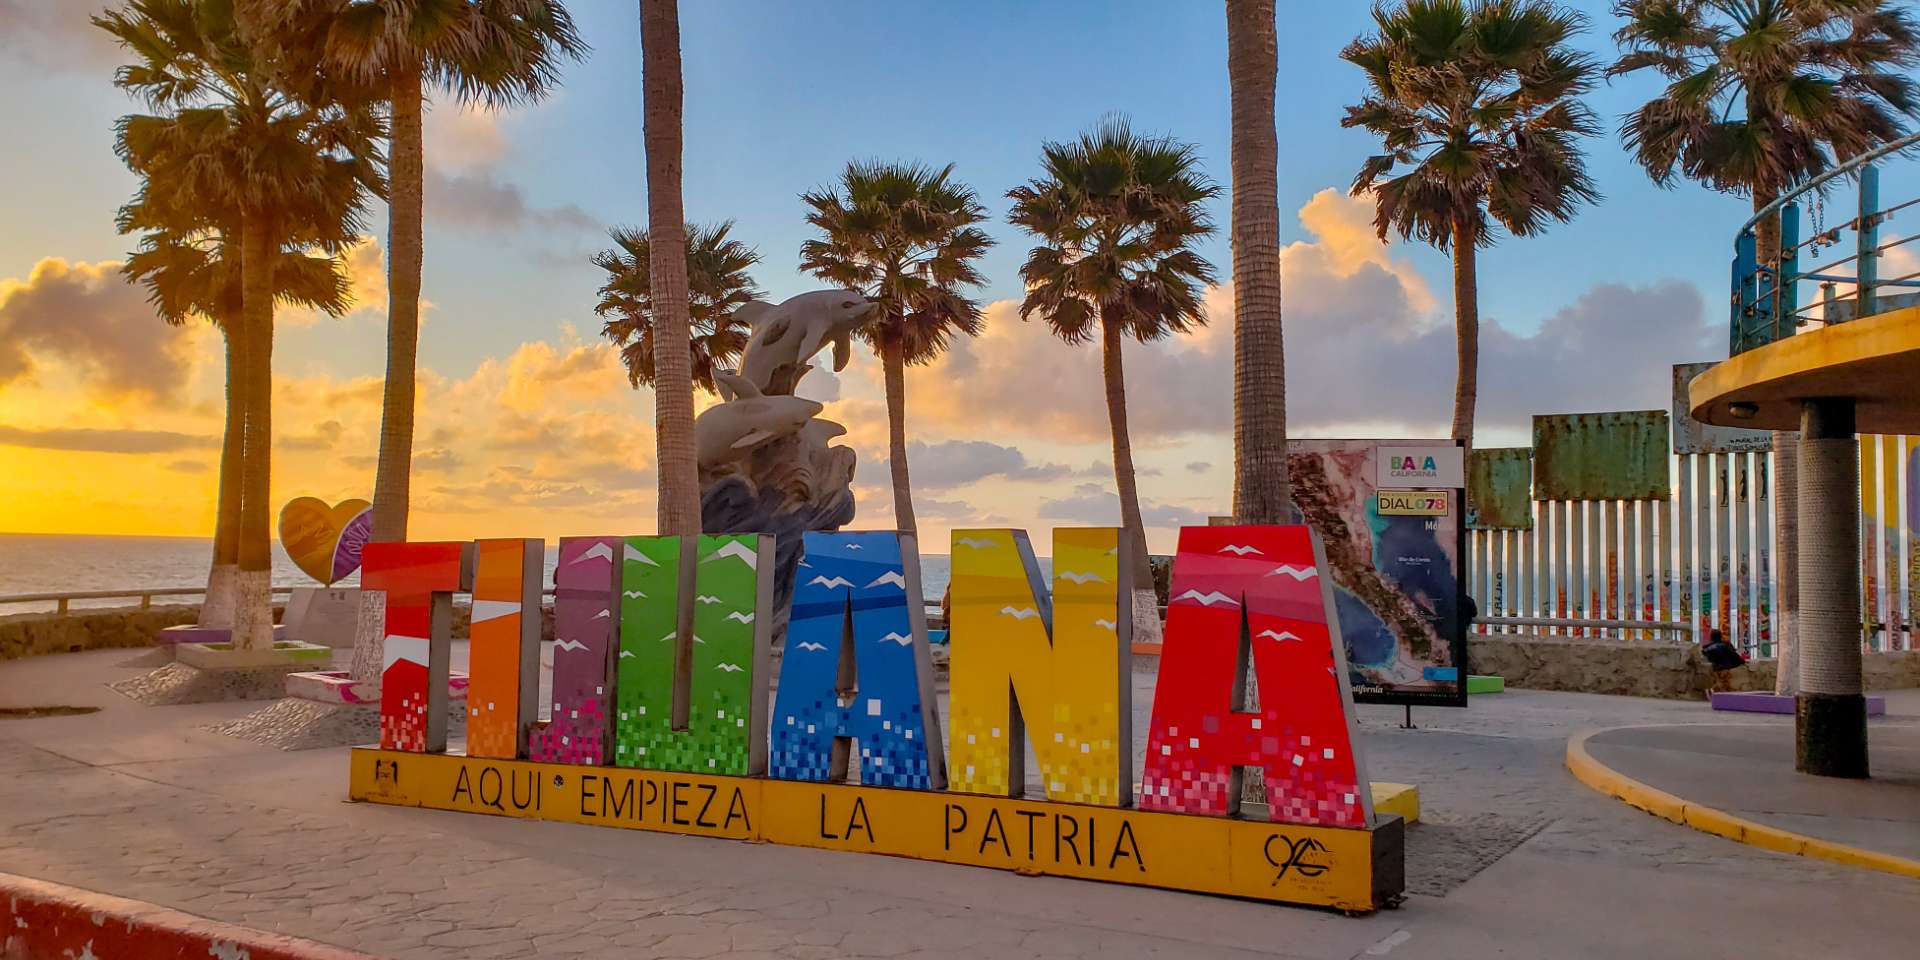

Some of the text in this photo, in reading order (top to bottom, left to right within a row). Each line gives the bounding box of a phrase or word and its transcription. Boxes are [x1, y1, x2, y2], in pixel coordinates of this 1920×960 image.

[1380, 498, 1446, 510] DIAL 078
[361, 522, 1376, 829] TIJUANA
[1350, 684, 1384, 695] alifornia
[452, 765, 1146, 872] AQUI EMPIEZA LA PATRIA
